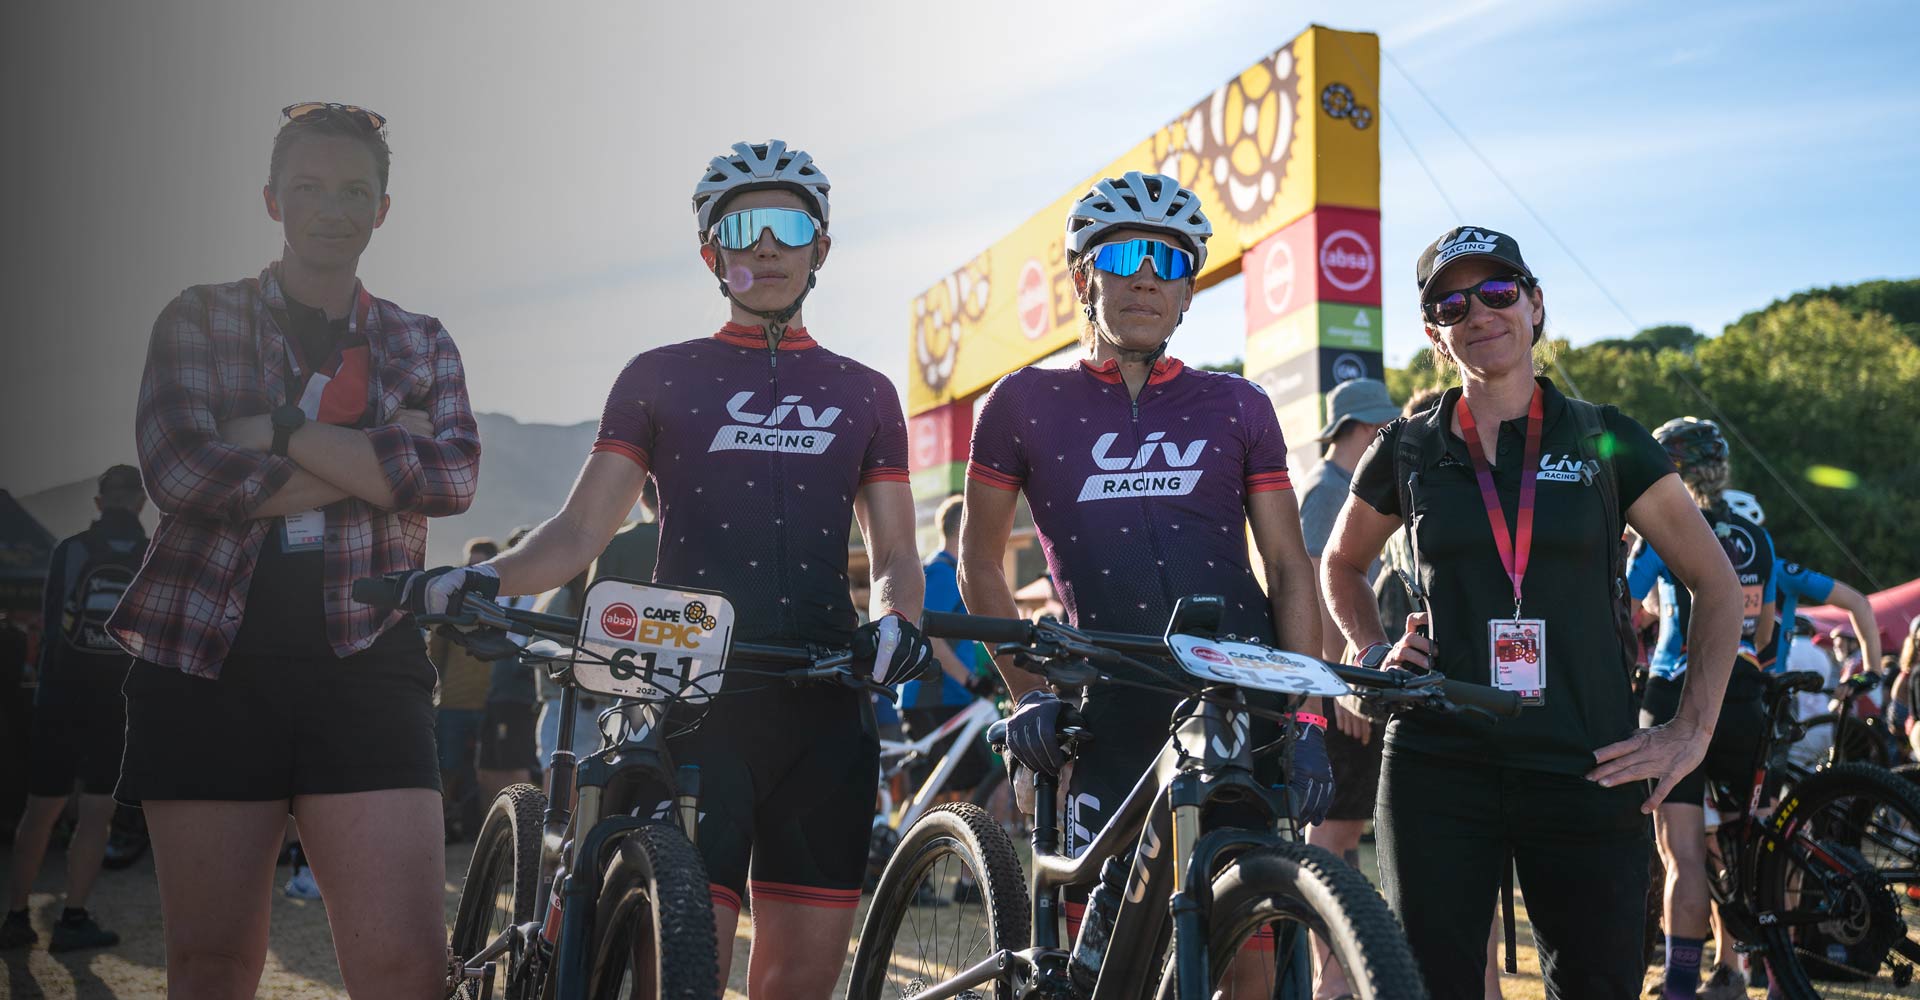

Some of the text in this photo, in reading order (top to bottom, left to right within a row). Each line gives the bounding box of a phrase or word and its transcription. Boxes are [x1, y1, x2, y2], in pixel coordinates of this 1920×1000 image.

[1436, 228, 1499, 252] Liv
[1327, 247, 1368, 270] absa
[1441, 243, 1486, 260] RACING
[726, 391, 842, 428] Liv
[734, 430, 815, 448] RACING
[1091, 431, 1208, 471] Liv
[1102, 476, 1181, 493] RACING
[1544, 472, 1576, 480] RACING
[1739, 574, 1758, 584] om
[606, 613, 632, 627] absa
[643, 607, 681, 623] CAPE
[638, 619, 702, 649] EPIC
[1228, 651, 1267, 662] CAPE
[609, 648, 693, 688] 61-1
[1208, 665, 1322, 691] 61-2
[636, 687, 657, 696] 2022
